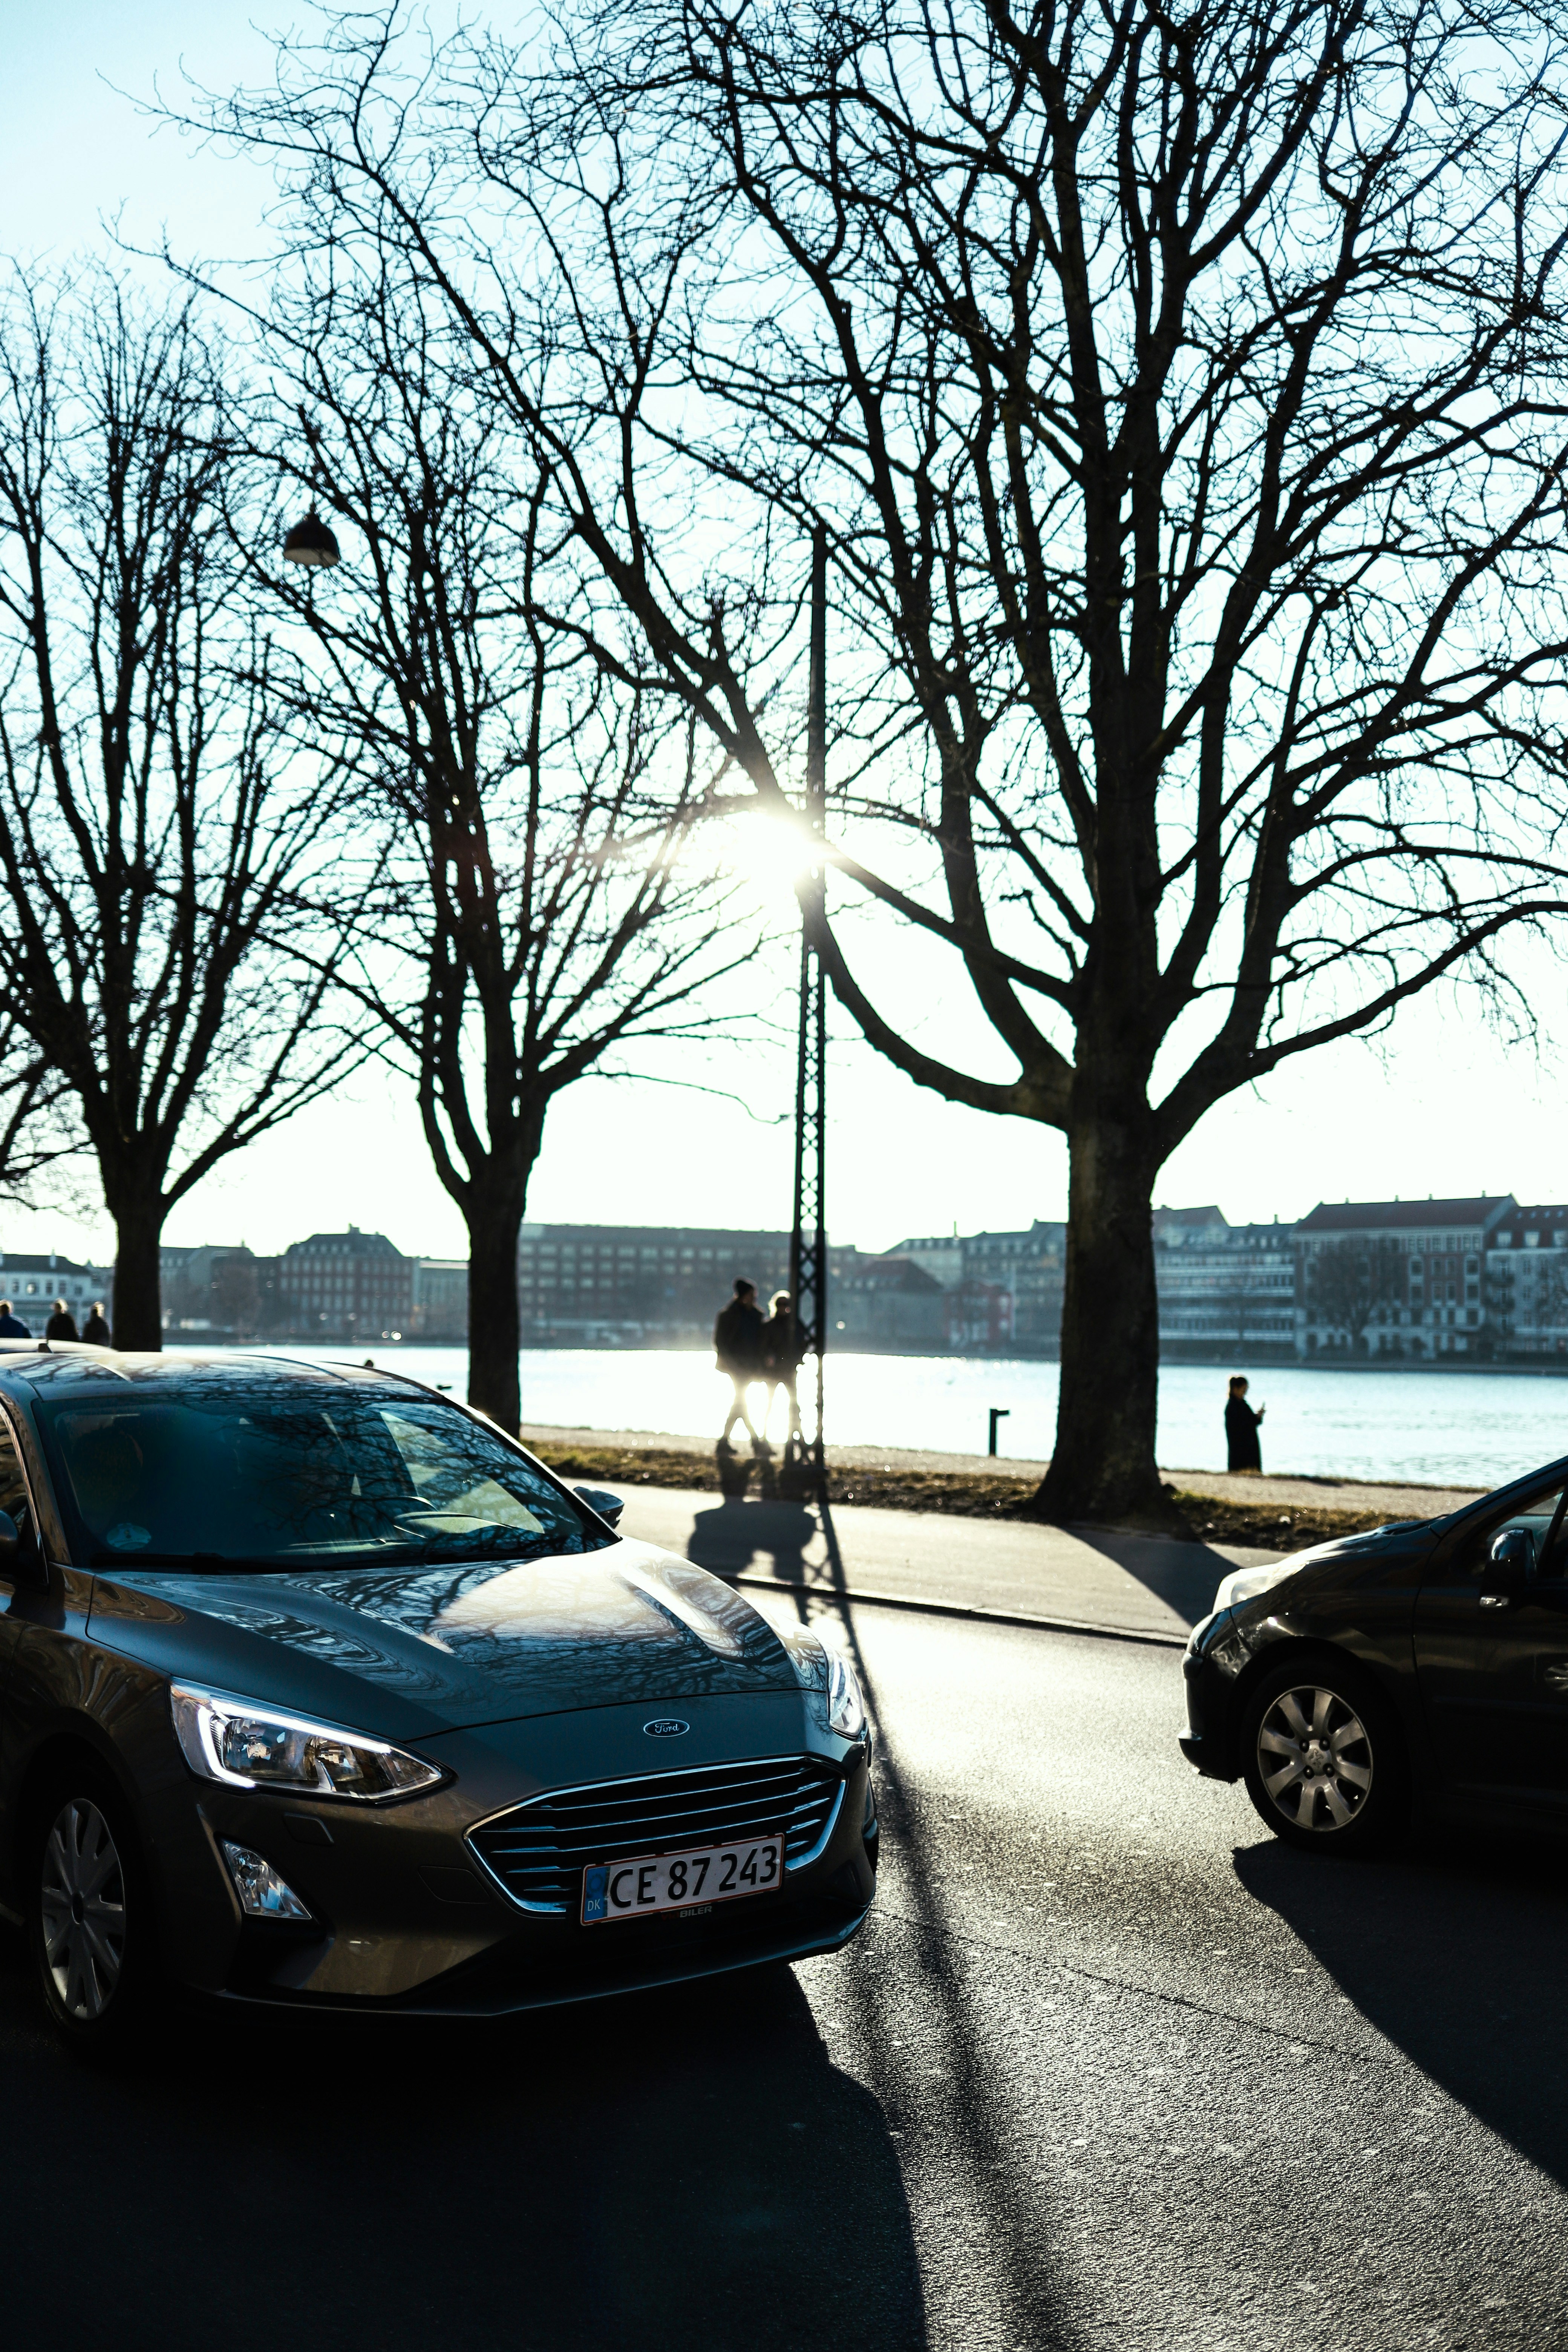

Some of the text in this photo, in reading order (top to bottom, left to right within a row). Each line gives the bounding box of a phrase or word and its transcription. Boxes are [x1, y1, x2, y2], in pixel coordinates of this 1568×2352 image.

[655, 1723, 680, 1733] Ford
[609, 1845, 778, 1908] CE 87 243
[588, 1898, 600, 1911] DK
